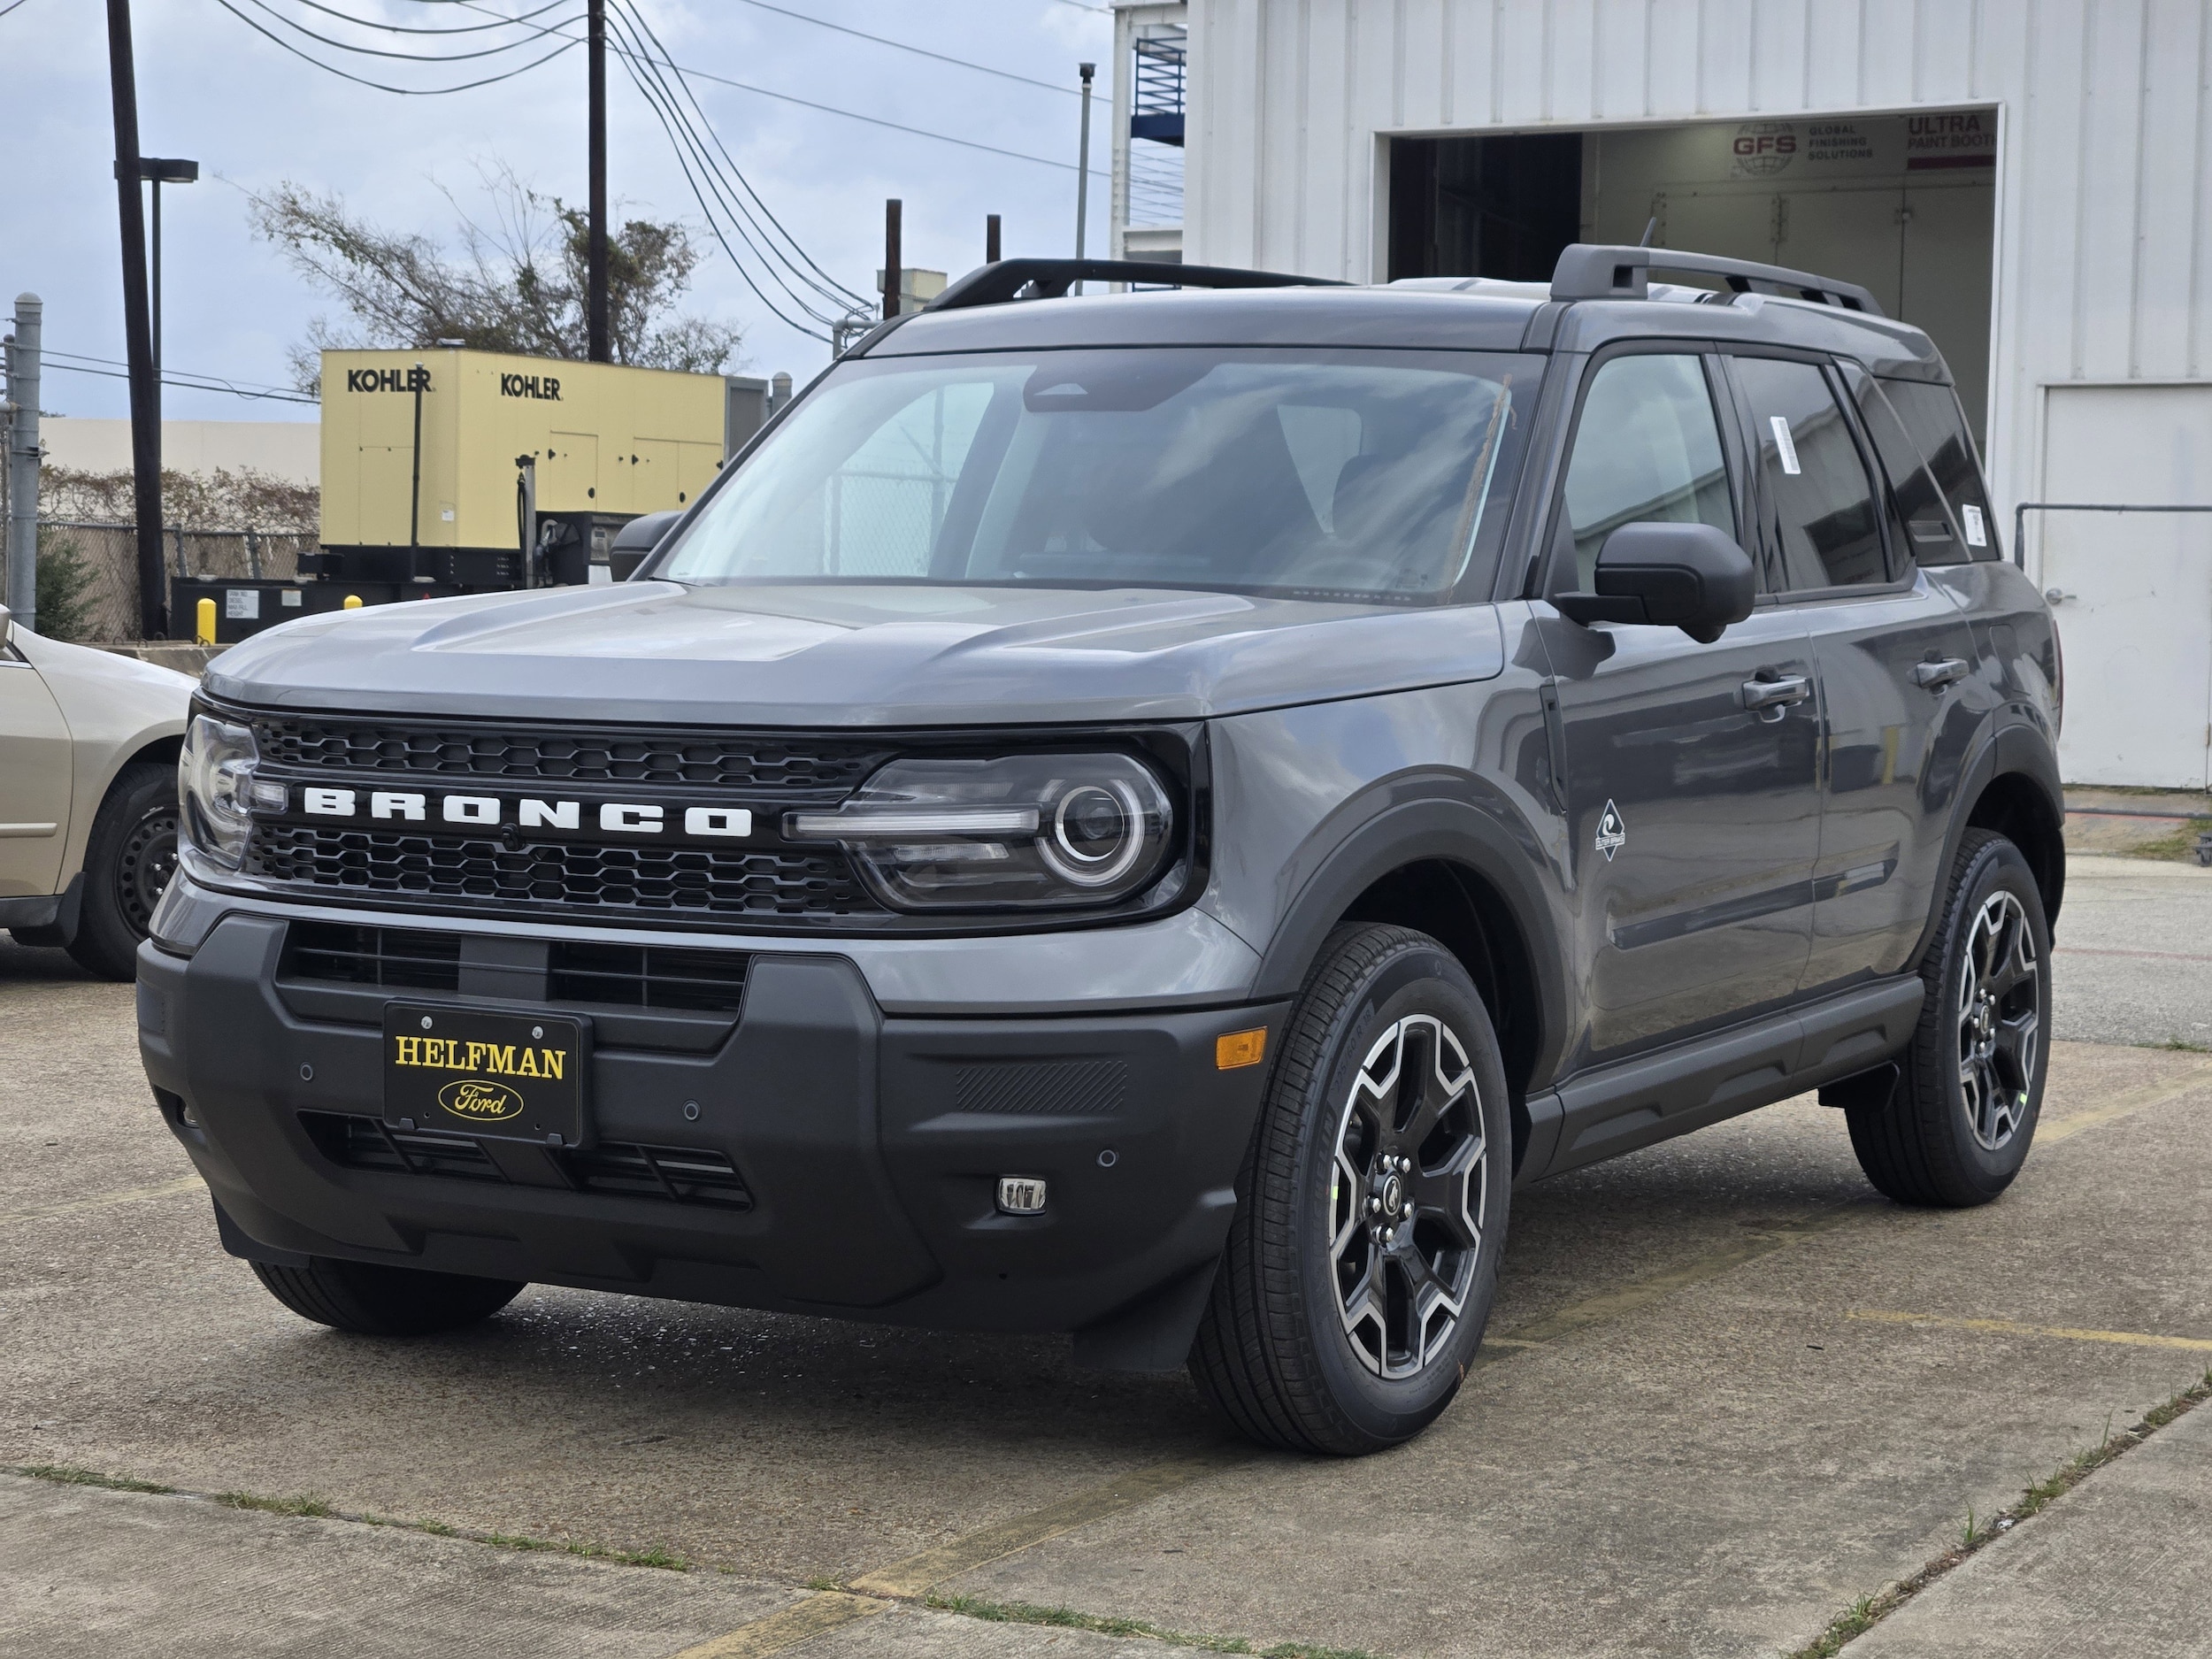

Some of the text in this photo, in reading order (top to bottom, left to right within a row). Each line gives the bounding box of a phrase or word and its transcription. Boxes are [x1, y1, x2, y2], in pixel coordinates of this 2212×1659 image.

[1809, 126, 1855, 135] GLOBAL
[1909, 115, 1980, 134] ULTRA
[1733, 135, 1797, 155] GFS
[1809, 136, 1867, 148] FINISHING
[1908, 135, 1947, 150] PAINT
[1808, 148, 1873, 160] SOLUTIONS
[348, 369, 433, 392] KOHLER
[501, 373, 561, 401] KOHLER
[304, 787, 753, 837] BRONCO
[396, 1035, 566, 1079] HELFMAN
[454, 1084, 508, 1115] Ford
